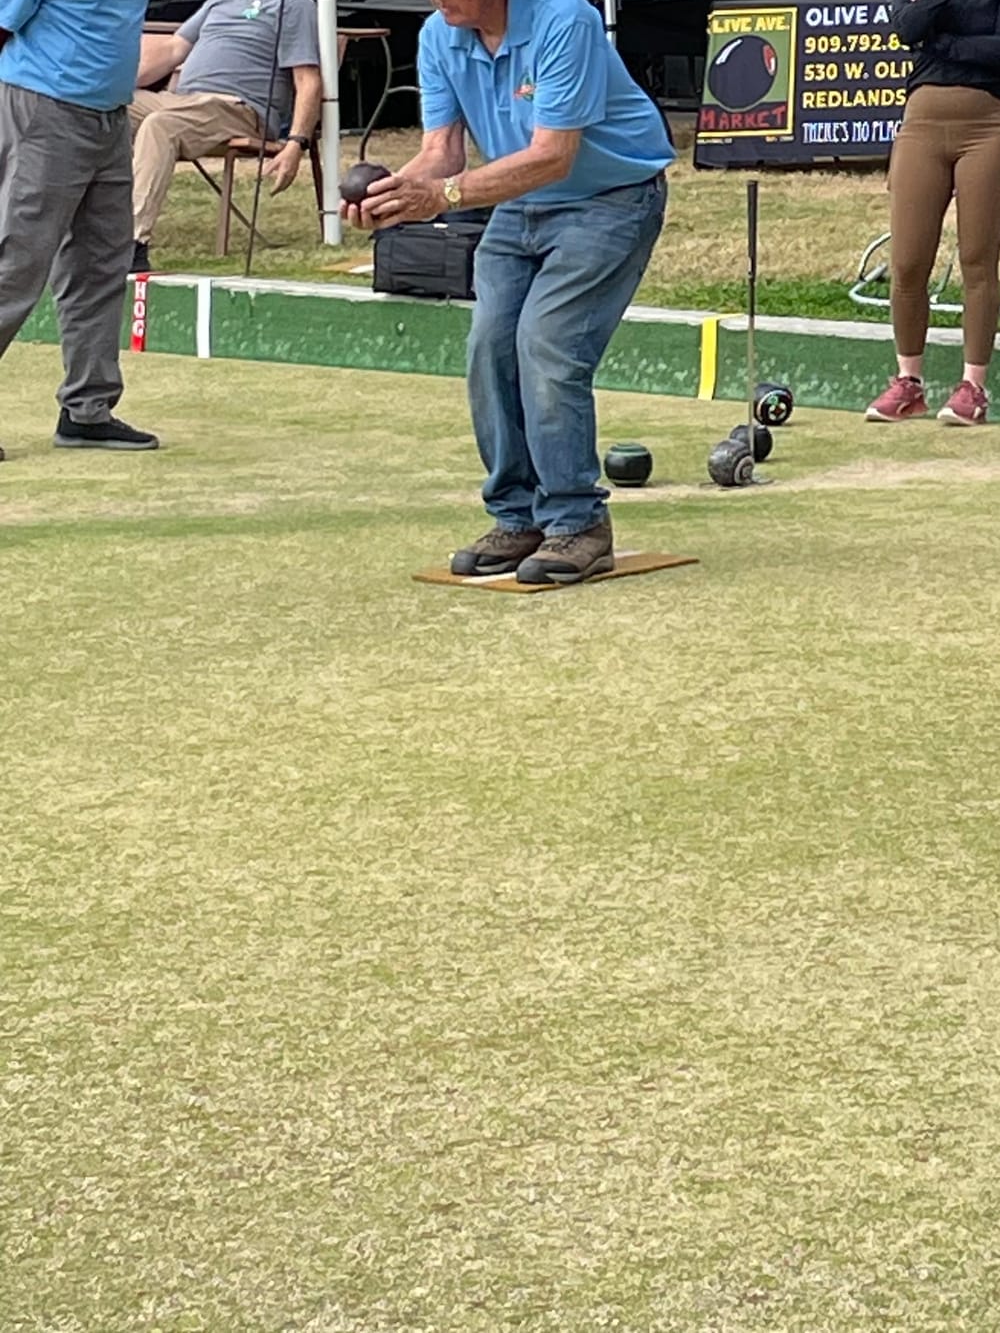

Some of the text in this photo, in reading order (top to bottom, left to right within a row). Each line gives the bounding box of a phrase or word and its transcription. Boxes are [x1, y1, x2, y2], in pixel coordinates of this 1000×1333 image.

[805, 5, 868, 26] OLIVE
[804, 62, 838, 81] 530
[844, 61, 869, 80] W.
[802, 88, 907, 109] REDLANDS
[701, 105, 787, 130] MARKET
[852, 120, 870, 142] NO
[132, 281, 147, 338] HOG
